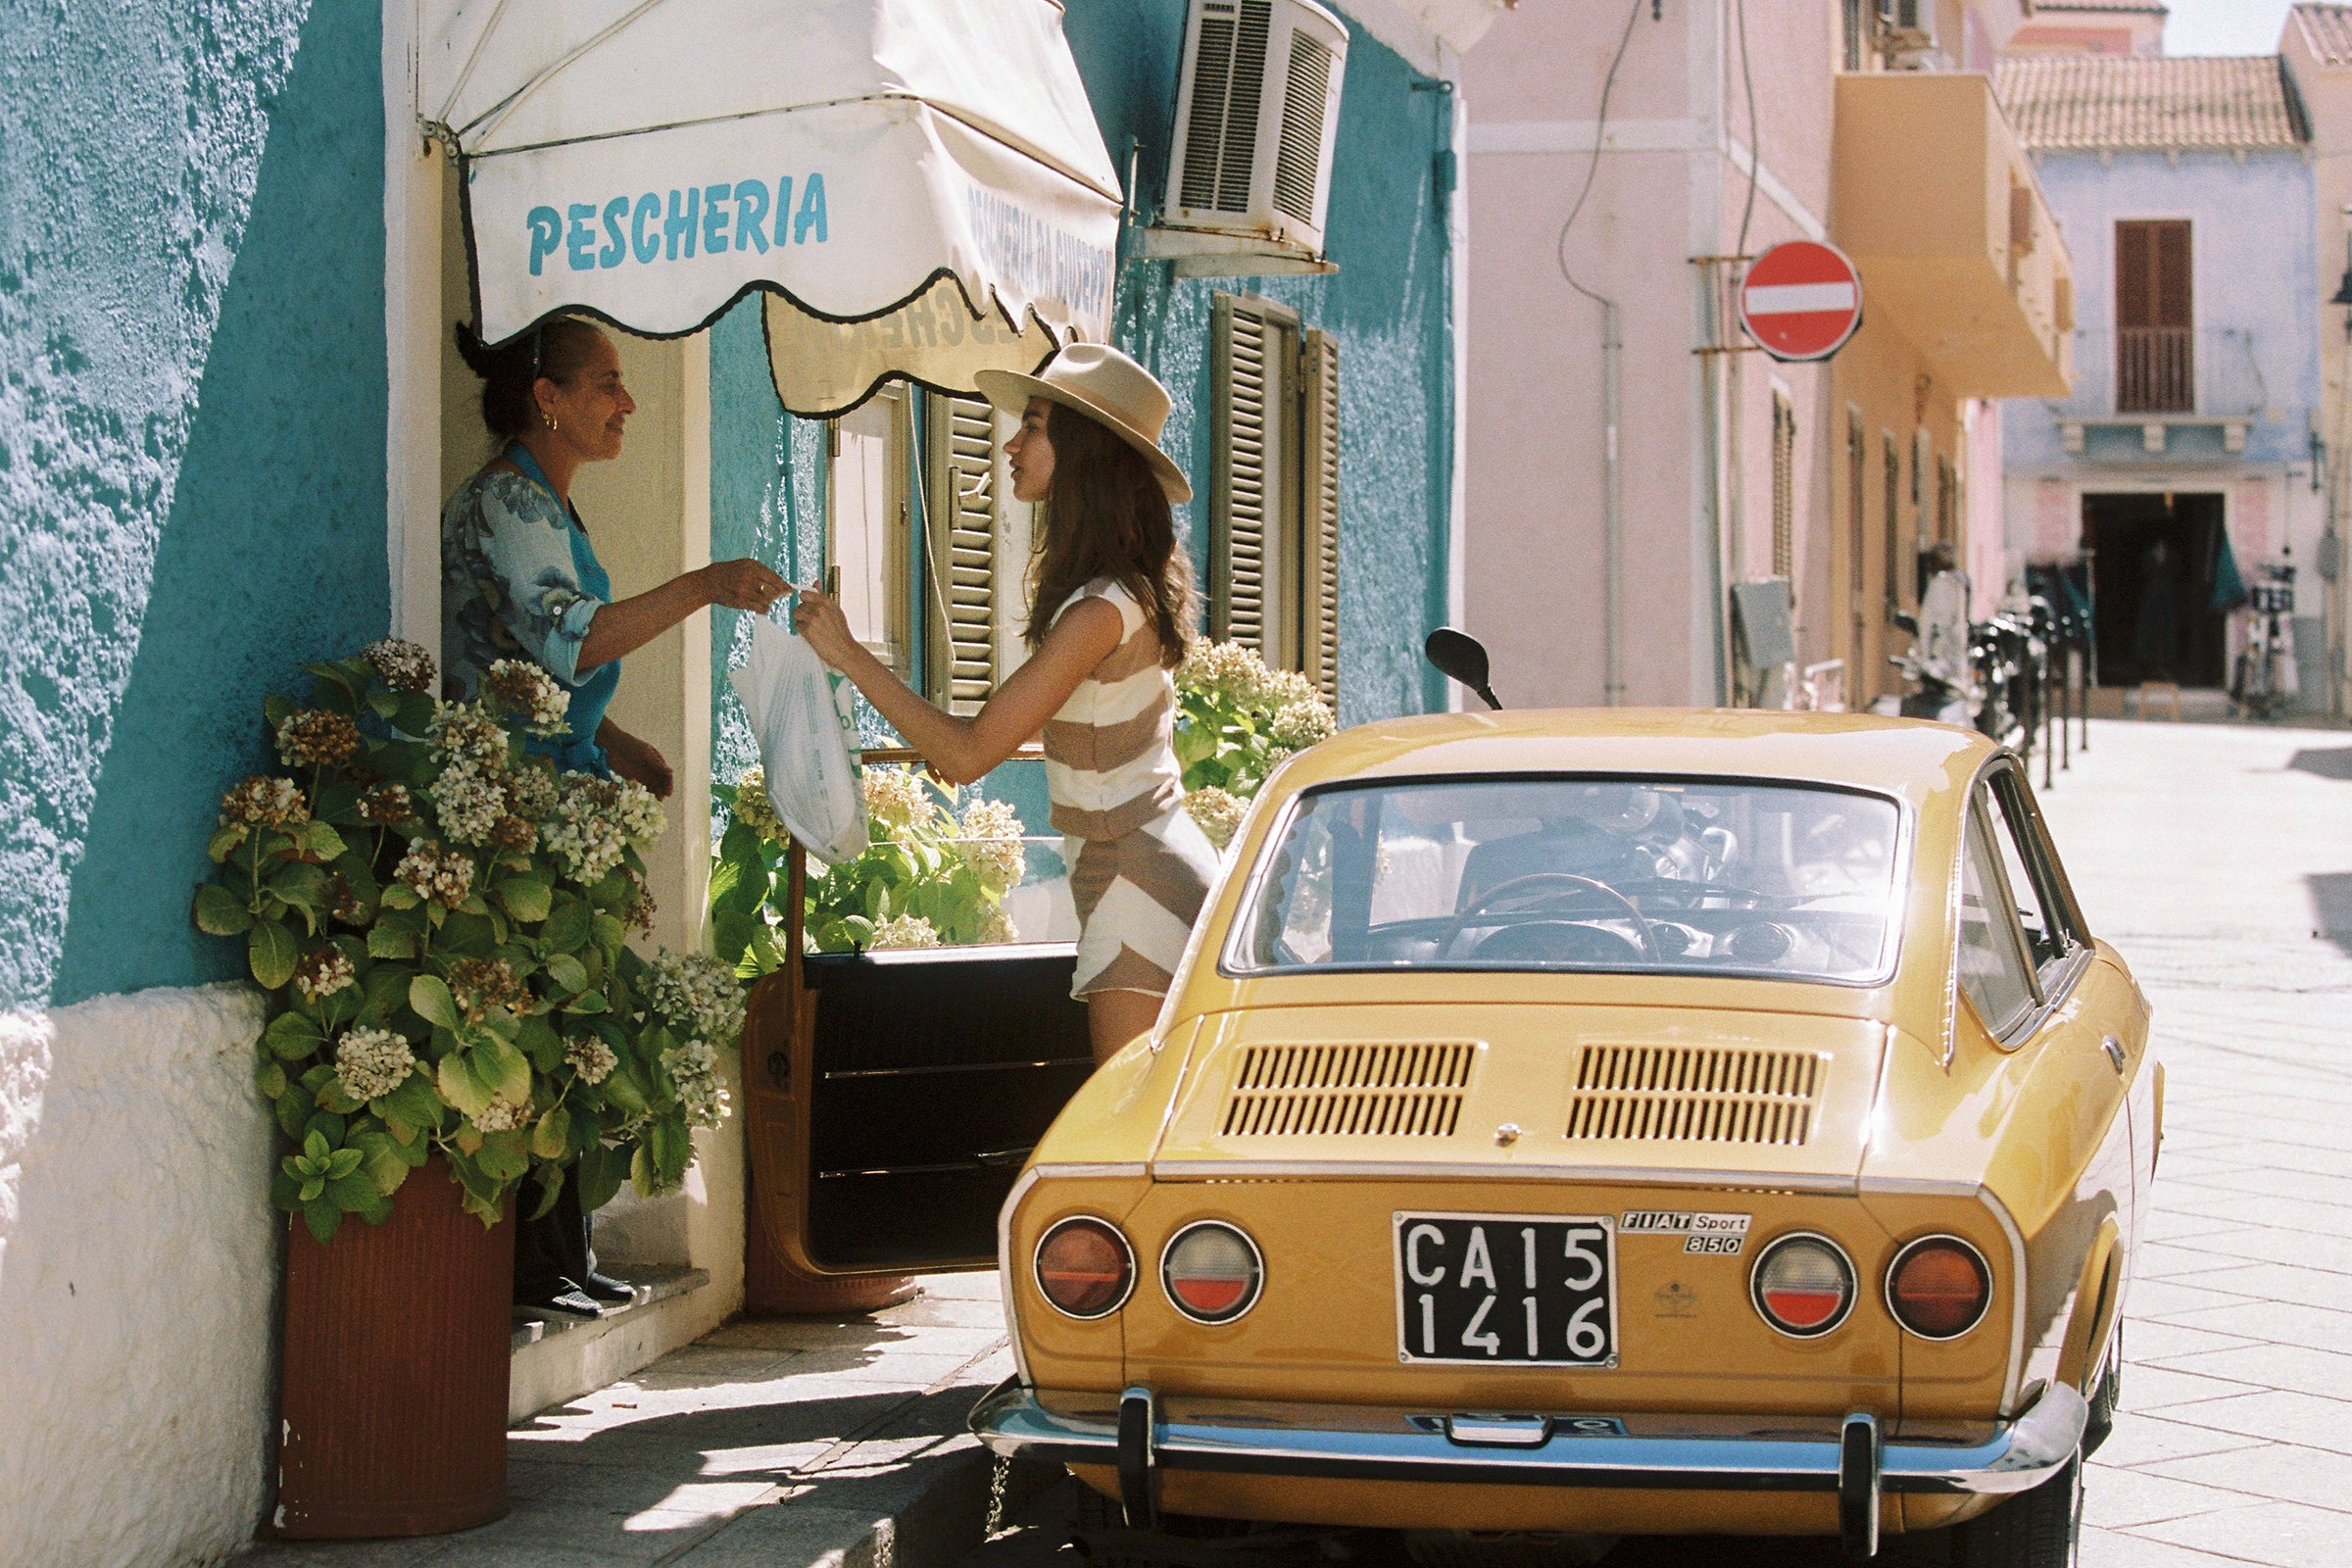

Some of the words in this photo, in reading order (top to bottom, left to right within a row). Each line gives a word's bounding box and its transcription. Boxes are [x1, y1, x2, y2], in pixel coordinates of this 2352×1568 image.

[526, 172, 829, 276] PESCHERIA
[1622, 1213, 1691, 1229] FIAT
[1695, 1215, 1745, 1230] Sport
[1688, 1237, 1740, 1252] 850
[1418, 1294, 1605, 1357] 1416
